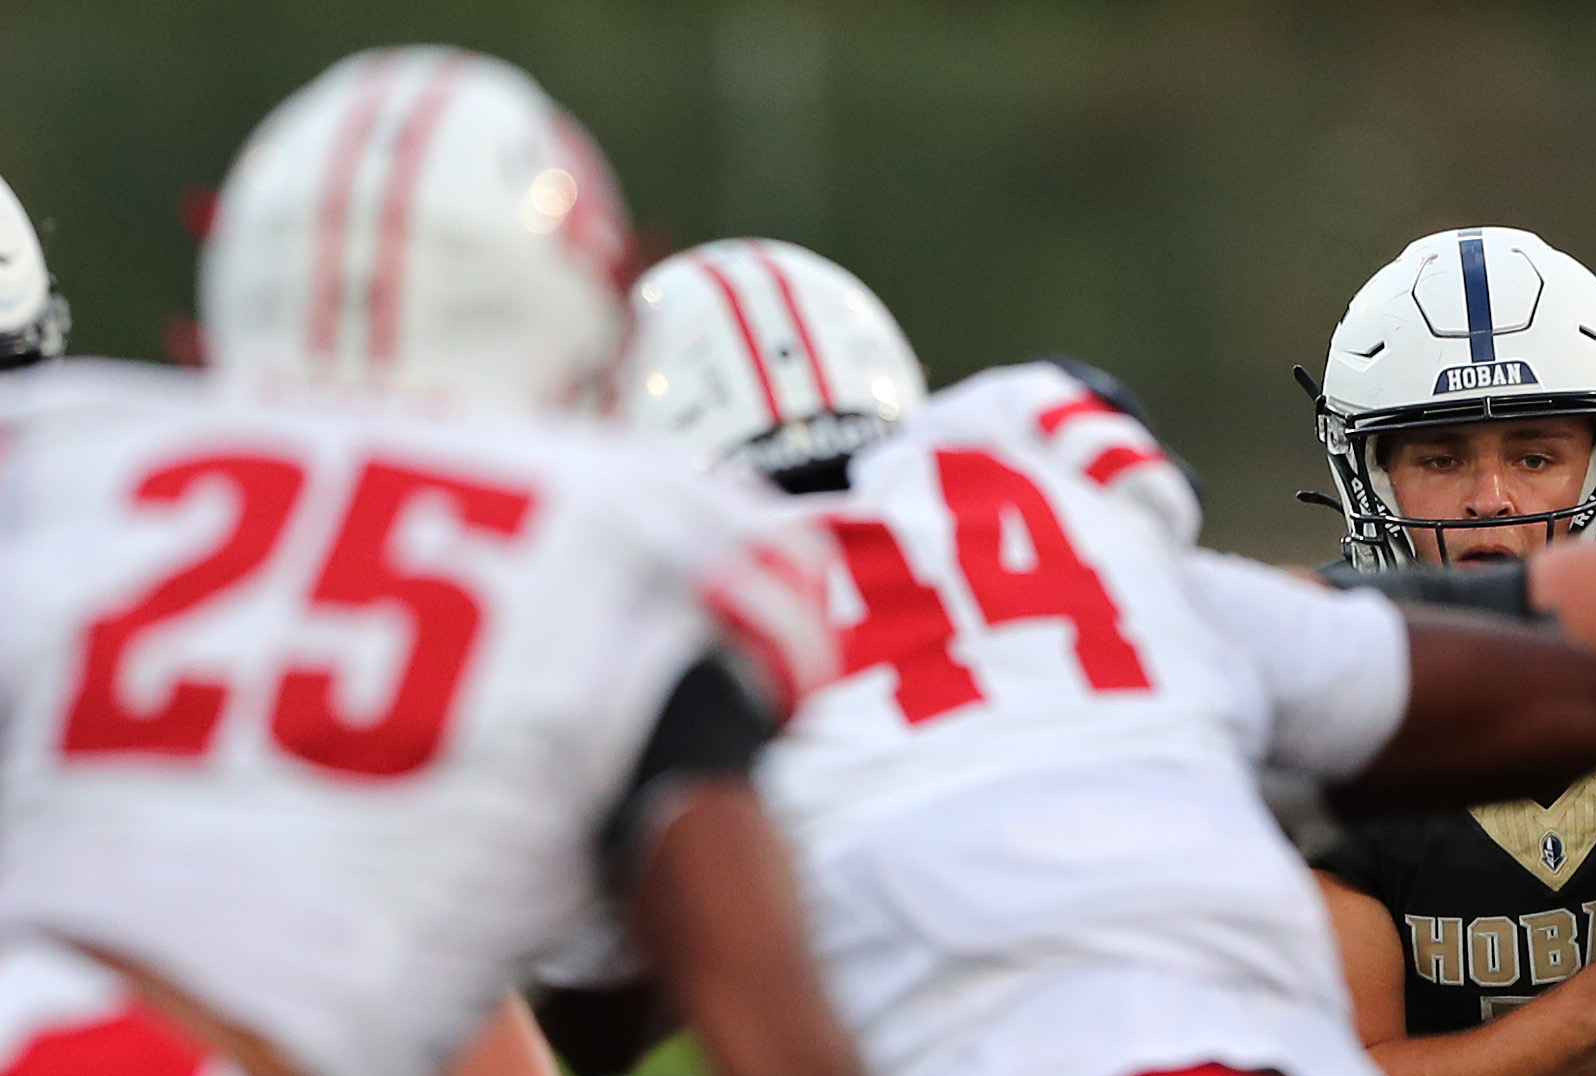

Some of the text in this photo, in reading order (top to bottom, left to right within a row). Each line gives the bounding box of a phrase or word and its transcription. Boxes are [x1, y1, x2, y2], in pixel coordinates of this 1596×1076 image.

[1446, 362, 1522, 392] HOBAN
[60, 453, 537, 779] 25
[825, 446, 1159, 729] 44
